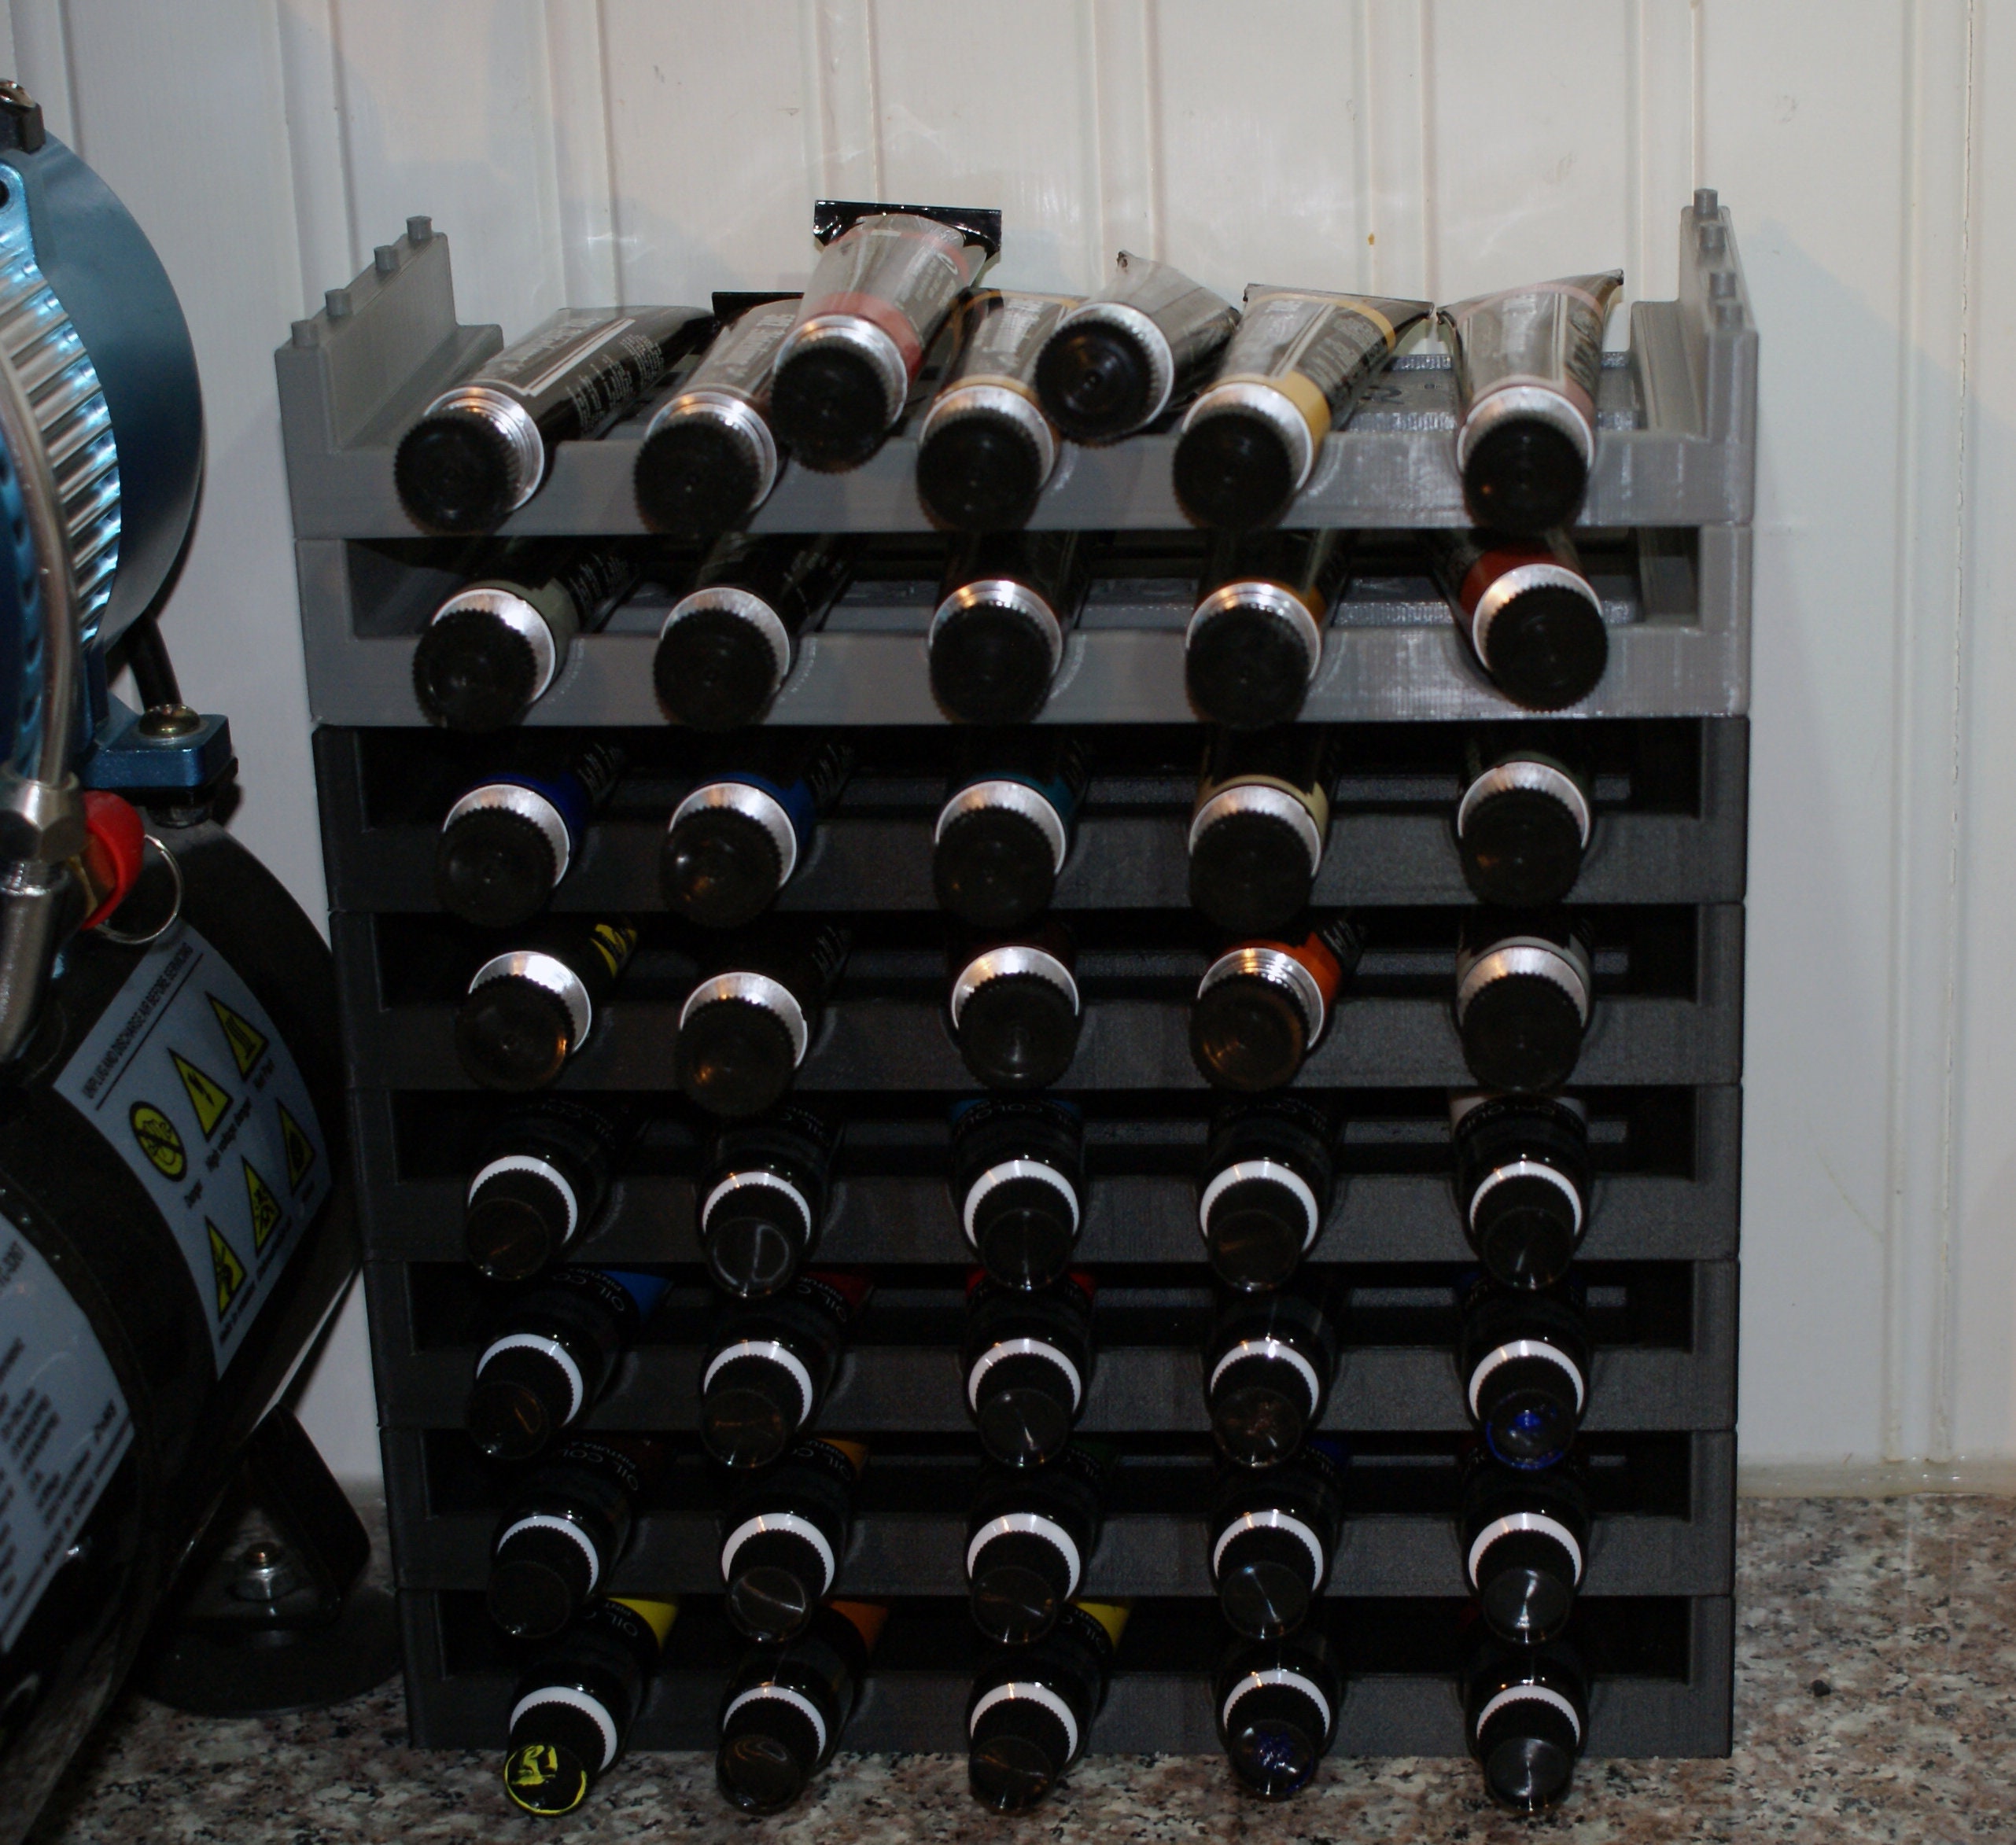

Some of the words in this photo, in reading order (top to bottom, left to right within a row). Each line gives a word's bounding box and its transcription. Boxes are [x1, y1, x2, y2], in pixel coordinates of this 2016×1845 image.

[595, 1282, 625, 1311] OIL
[612, 1460, 639, 1491] OIL
[606, 1611, 638, 1637] OIL
